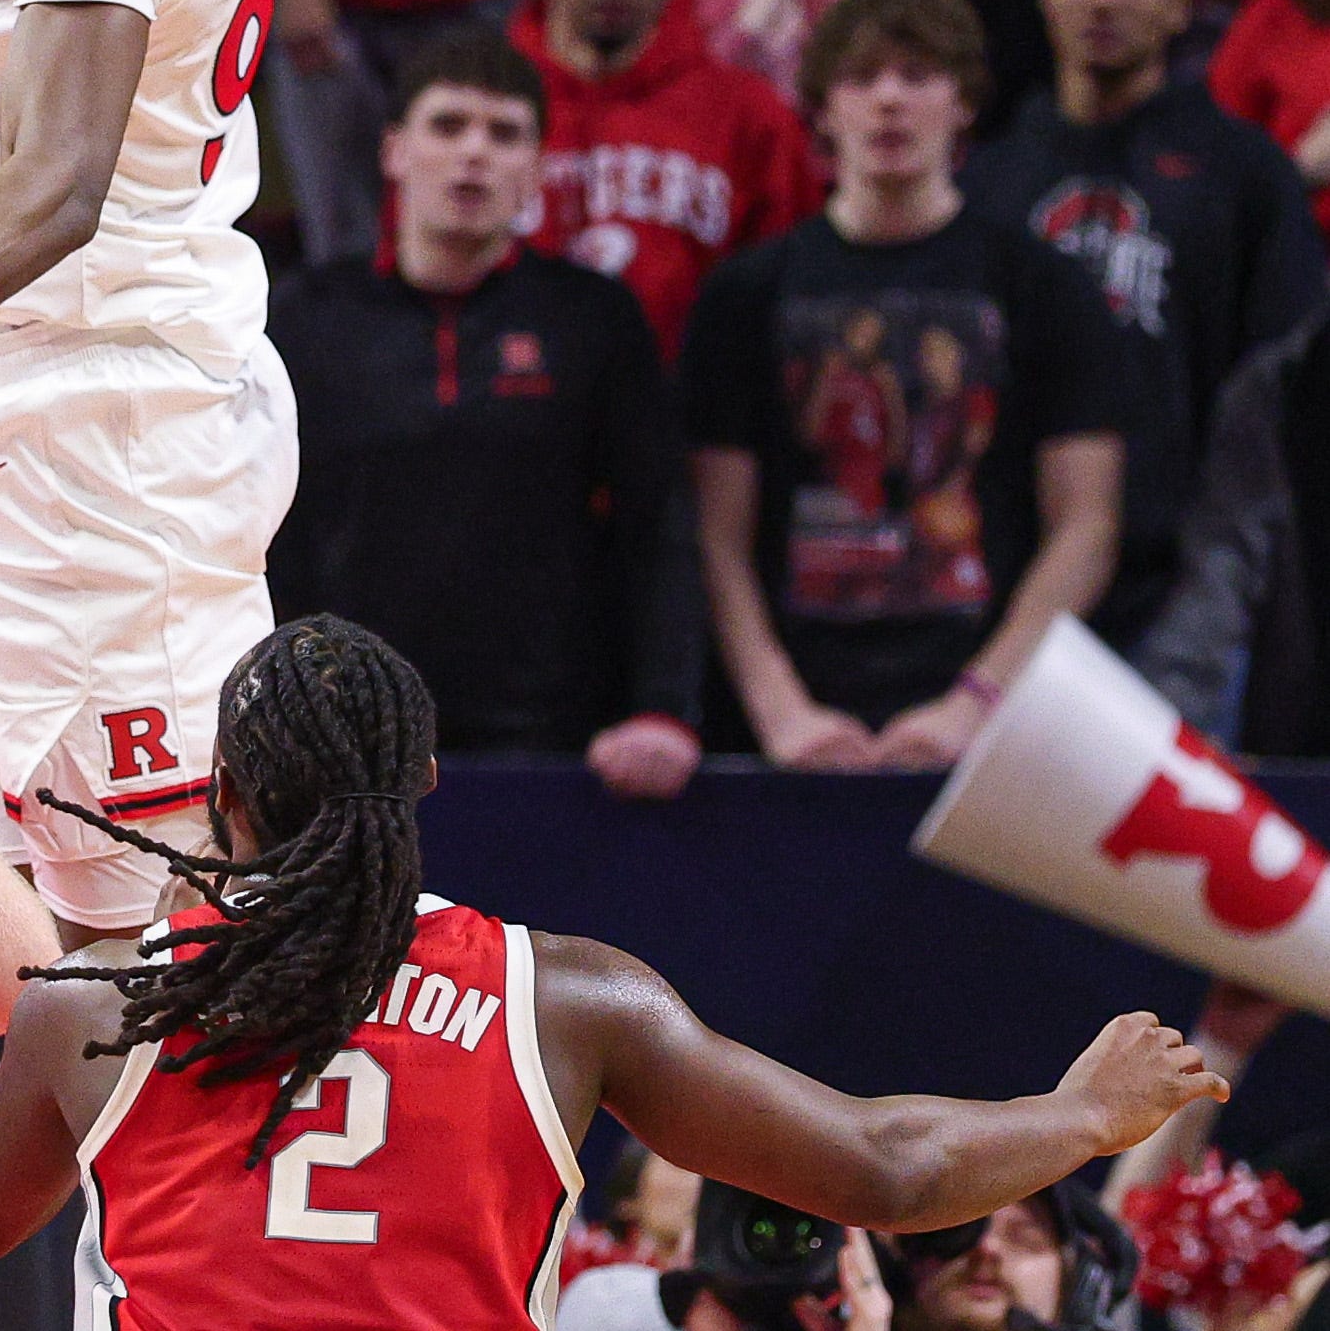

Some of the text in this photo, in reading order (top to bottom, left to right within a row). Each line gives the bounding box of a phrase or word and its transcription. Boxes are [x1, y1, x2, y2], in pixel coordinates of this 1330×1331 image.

[100, 706, 179, 782] R
[364, 963, 503, 1053] TON
[264, 1048, 391, 1245] 2
